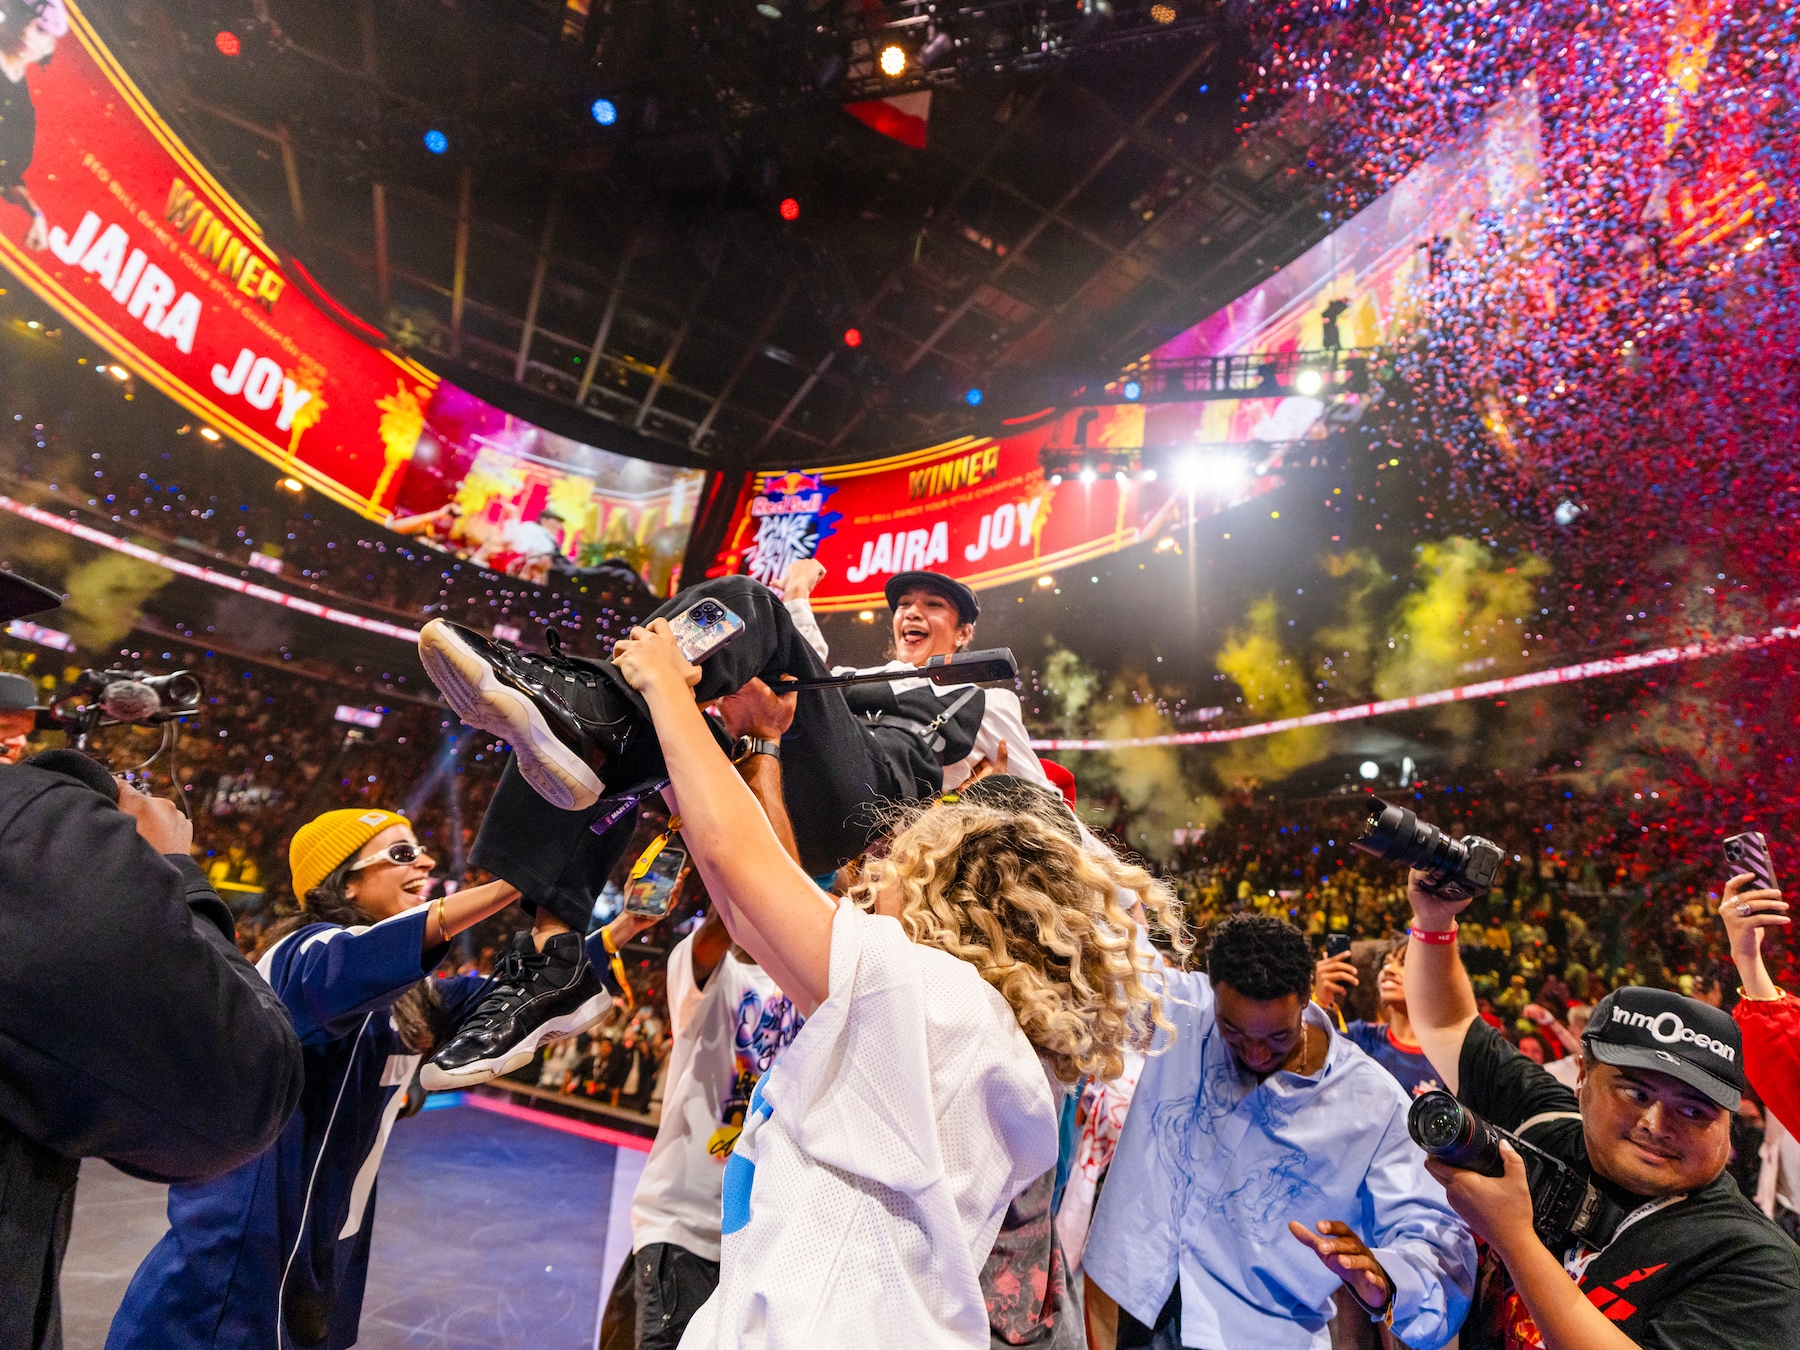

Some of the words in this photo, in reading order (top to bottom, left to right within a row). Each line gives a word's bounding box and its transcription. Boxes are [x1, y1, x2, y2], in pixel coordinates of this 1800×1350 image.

[164, 177, 286, 314] WINNER
[48, 210, 202, 354] JAIRA
[211, 348, 313, 431] JOY
[752, 495, 786, 517] Red
[786, 492, 822, 514] Bull
[908, 445, 999, 501] WINNER
[846, 520, 949, 583] JAIRA
[963, 497, 1042, 562] JOY
[611, 805, 626, 819] MAIN
